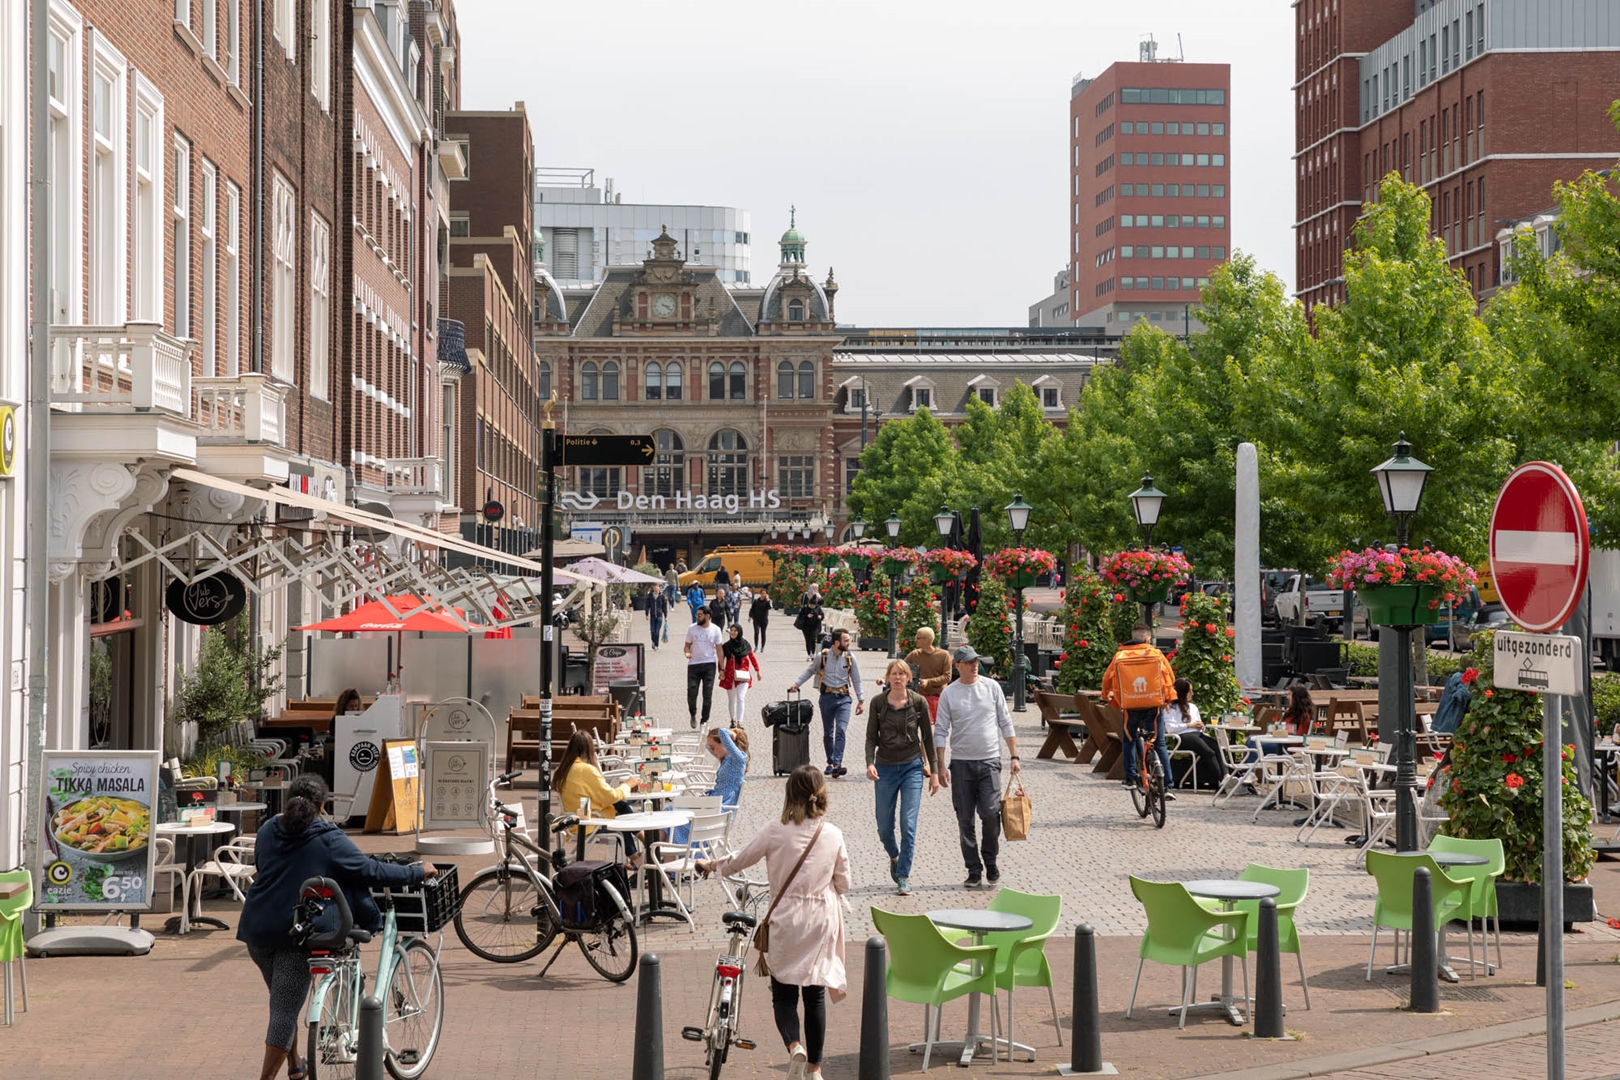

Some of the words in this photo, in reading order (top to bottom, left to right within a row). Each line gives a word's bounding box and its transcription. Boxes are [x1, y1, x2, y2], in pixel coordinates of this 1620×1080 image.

[565, 438, 590, 446] Politie
[630, 439, 641, 447] 0,3
[617, 490, 665, 510] Den
[675, 490, 739, 514] Haag
[749, 489, 781, 510] HS
[189, 595, 220, 611] Vers
[1497, 636, 1572, 658] uitgezonderd
[72, 762, 96, 775] Spicy
[98, 762, 131, 774] chicken
[56, 778, 93, 792] TIKKA
[97, 778, 145, 792] MASALA
[47, 885, 72, 895] eazie
